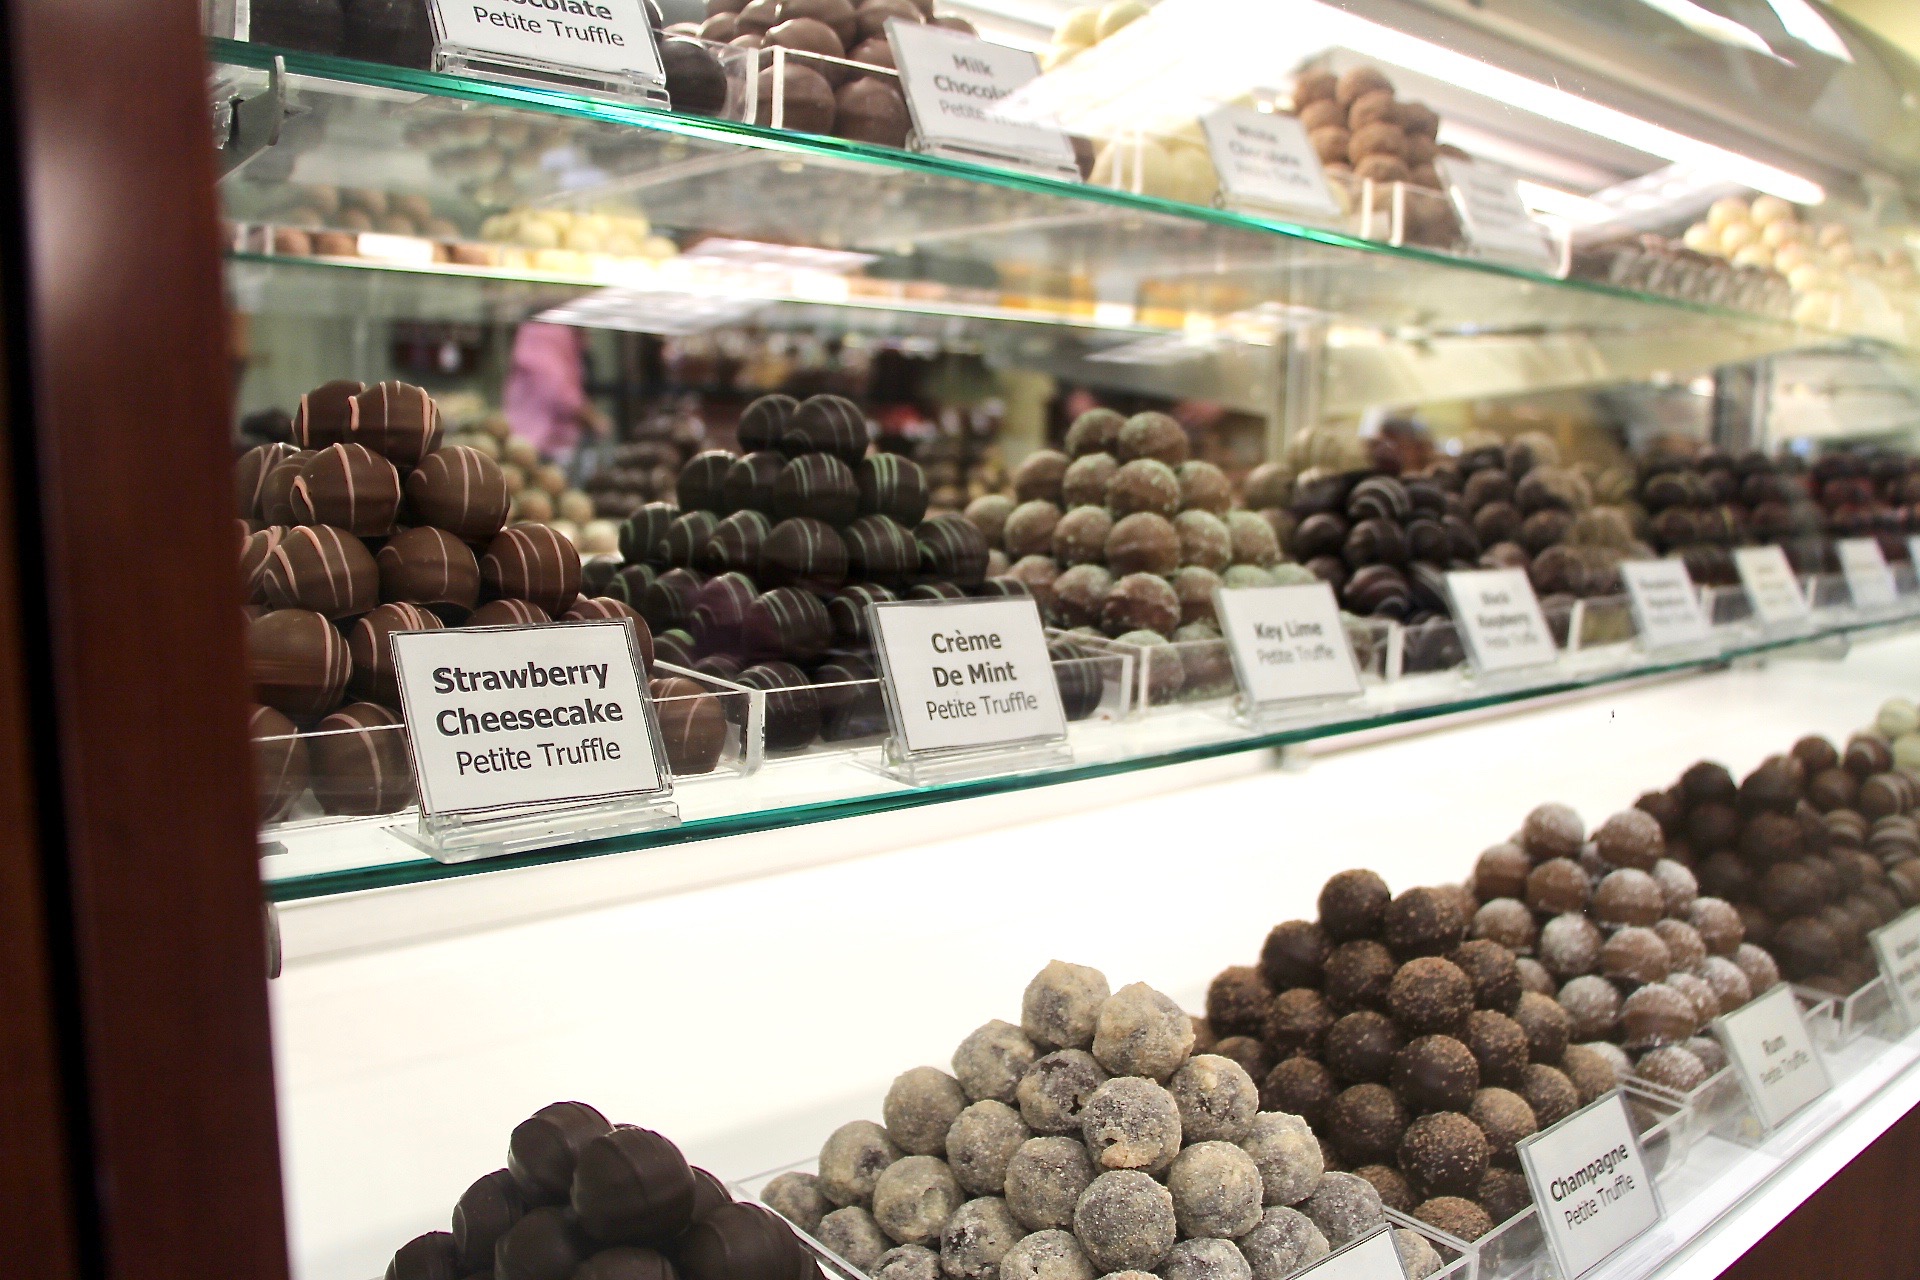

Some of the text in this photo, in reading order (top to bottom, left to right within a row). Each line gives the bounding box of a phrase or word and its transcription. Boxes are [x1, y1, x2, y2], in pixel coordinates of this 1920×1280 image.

[473, 6, 625, 47] Petite Truffle
[952, 53, 993, 77] Milk
[931, 629, 1002, 654] Crème
[1254, 620, 1323, 643] Key Lime
[432, 662, 608, 694] Strawberry
[932, 661, 1017, 688] De Mint
[436, 699, 623, 736] Cheesecake
[926, 691, 1038, 721] Petite Truffle
[456, 737, 621, 775] Petite Truffle
[1550, 1144, 1628, 1203] Champagne
[1564, 1174, 1635, 1230] Petite Truffle
